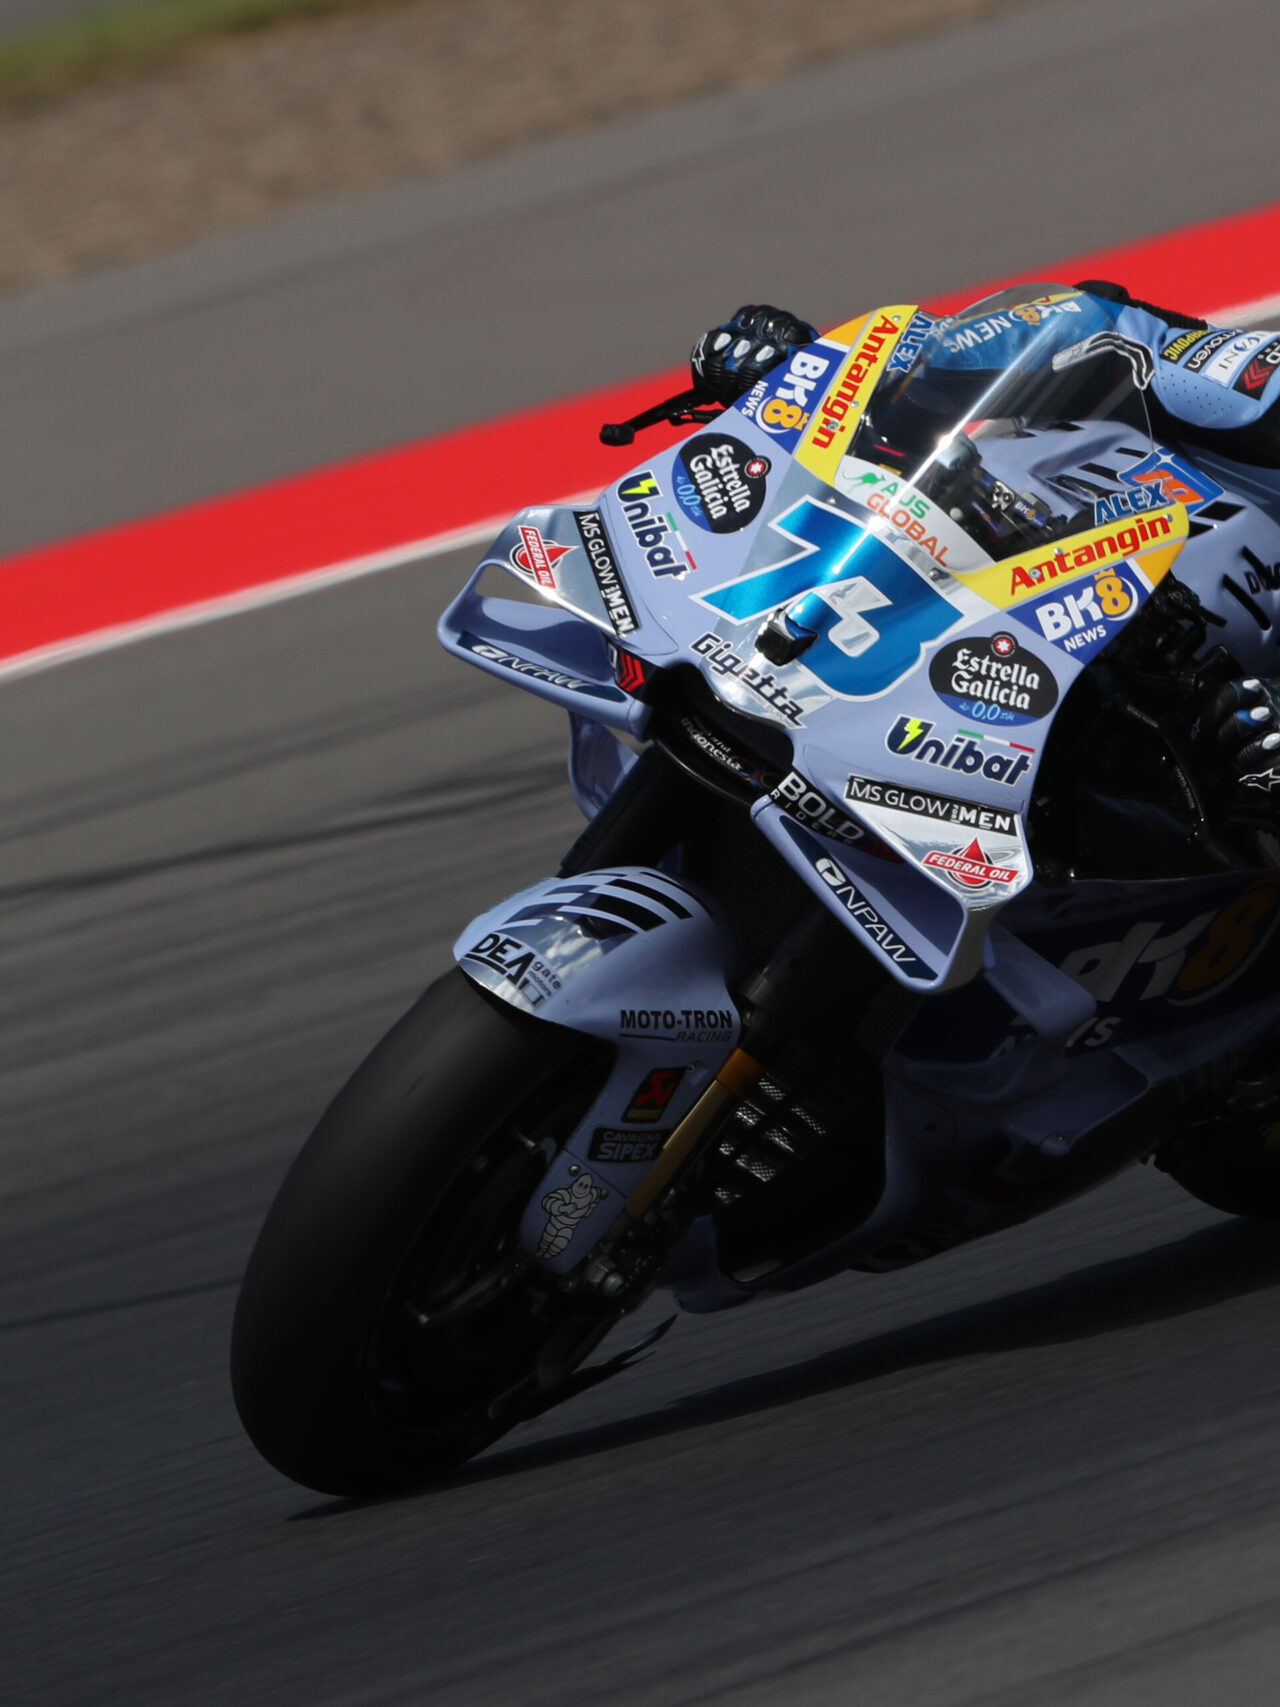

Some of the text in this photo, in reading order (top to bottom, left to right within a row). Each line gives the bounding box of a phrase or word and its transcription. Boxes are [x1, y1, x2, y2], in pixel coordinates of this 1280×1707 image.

[887, 313, 933, 374] ALEX
[741, 380, 765, 416] NEWS
[758, 351, 831, 433] BK8
[811, 316, 900, 449] Antangin
[690, 454, 727, 520] Galicia
[710, 444, 750, 513] Estrella
[1095, 482, 1170, 526] ALEX
[579, 512, 600, 541] MS
[616, 470, 690, 579] Unibat
[867, 493, 948, 567] GLOBAL
[526, 529, 552, 587] FEDERAL OIL
[588, 541, 612, 583] GLOW
[1010, 514, 1171, 595] Antangin
[605, 593, 634, 635] MEN
[1035, 570, 1134, 641] BK8
[1064, 625, 1107, 652] NEWS
[950, 670, 1031, 709] Galicia
[952, 649, 1040, 690] Estrella
[886, 716, 1033, 786] Unibat
[770, 789, 853, 844] RIDERS
[778, 771, 865, 841] BOLD
[850, 779, 882, 802] MS
[885, 789, 949, 817] GLOW
[959, 807, 1010, 832] MEN
[929, 854, 1014, 881] FEDERAL OIL
[836, 886, 916, 963] NPAW
[471, 933, 535, 986] DEA
[532, 961, 561, 990] gate
[620, 1010, 732, 1029] MOTO-TRON
[675, 1032, 732, 1043] RACING
[597, 1143, 657, 1161] SIPEX
